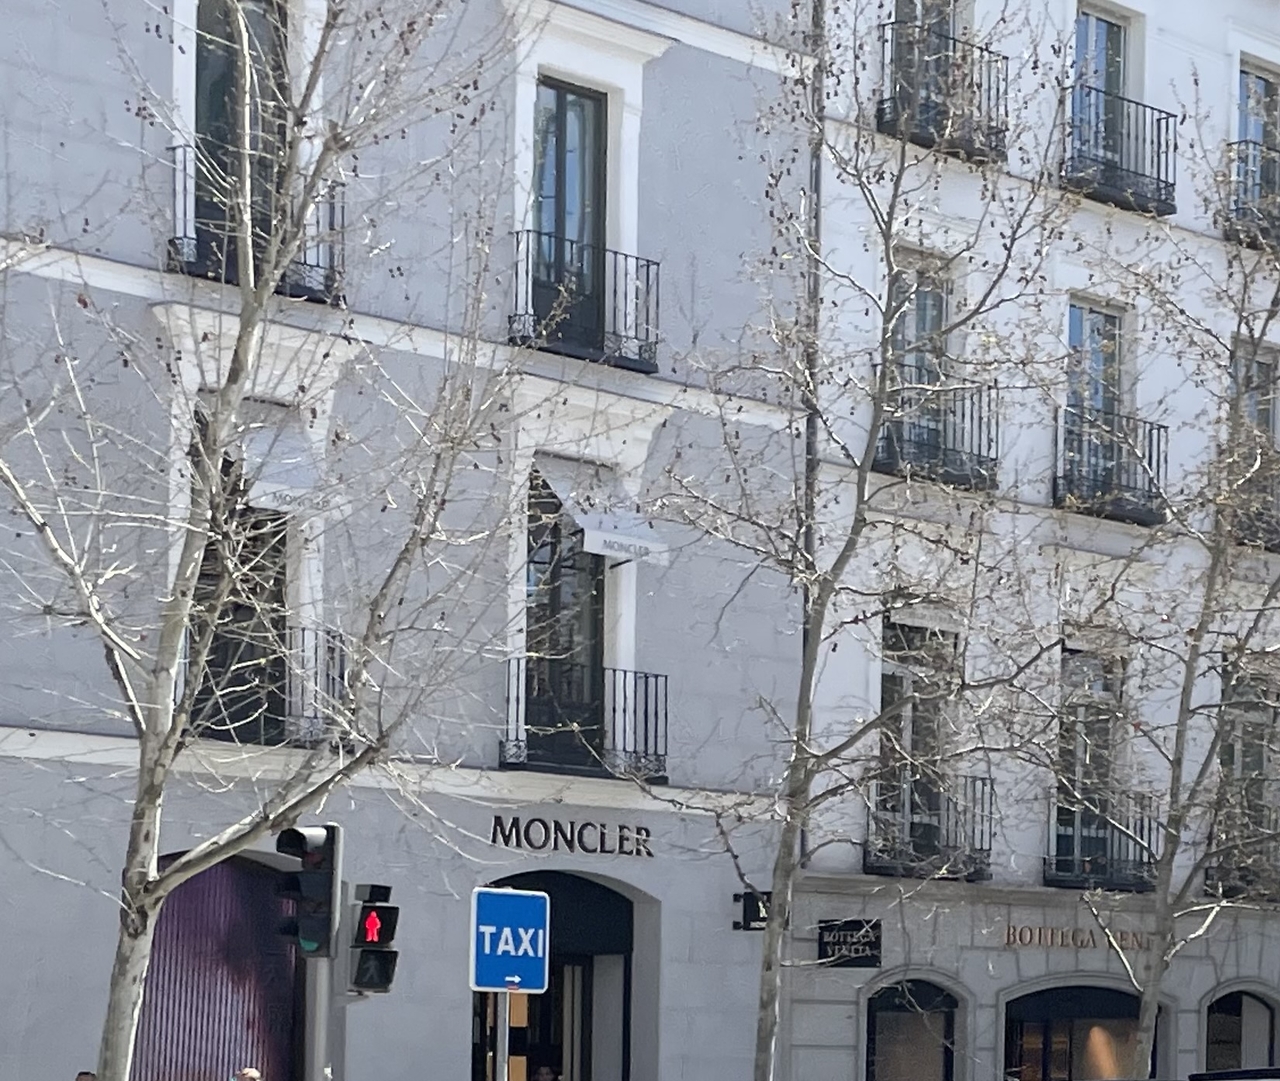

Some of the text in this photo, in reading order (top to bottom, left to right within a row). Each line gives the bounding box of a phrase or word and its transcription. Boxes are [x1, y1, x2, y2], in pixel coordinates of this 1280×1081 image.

[491, 815, 655, 858] MONCLER
[479, 924, 544, 958] TAXI
[823, 931, 876, 943] BOTTEGA
[1005, 924, 1098, 949] BOTTEGA
